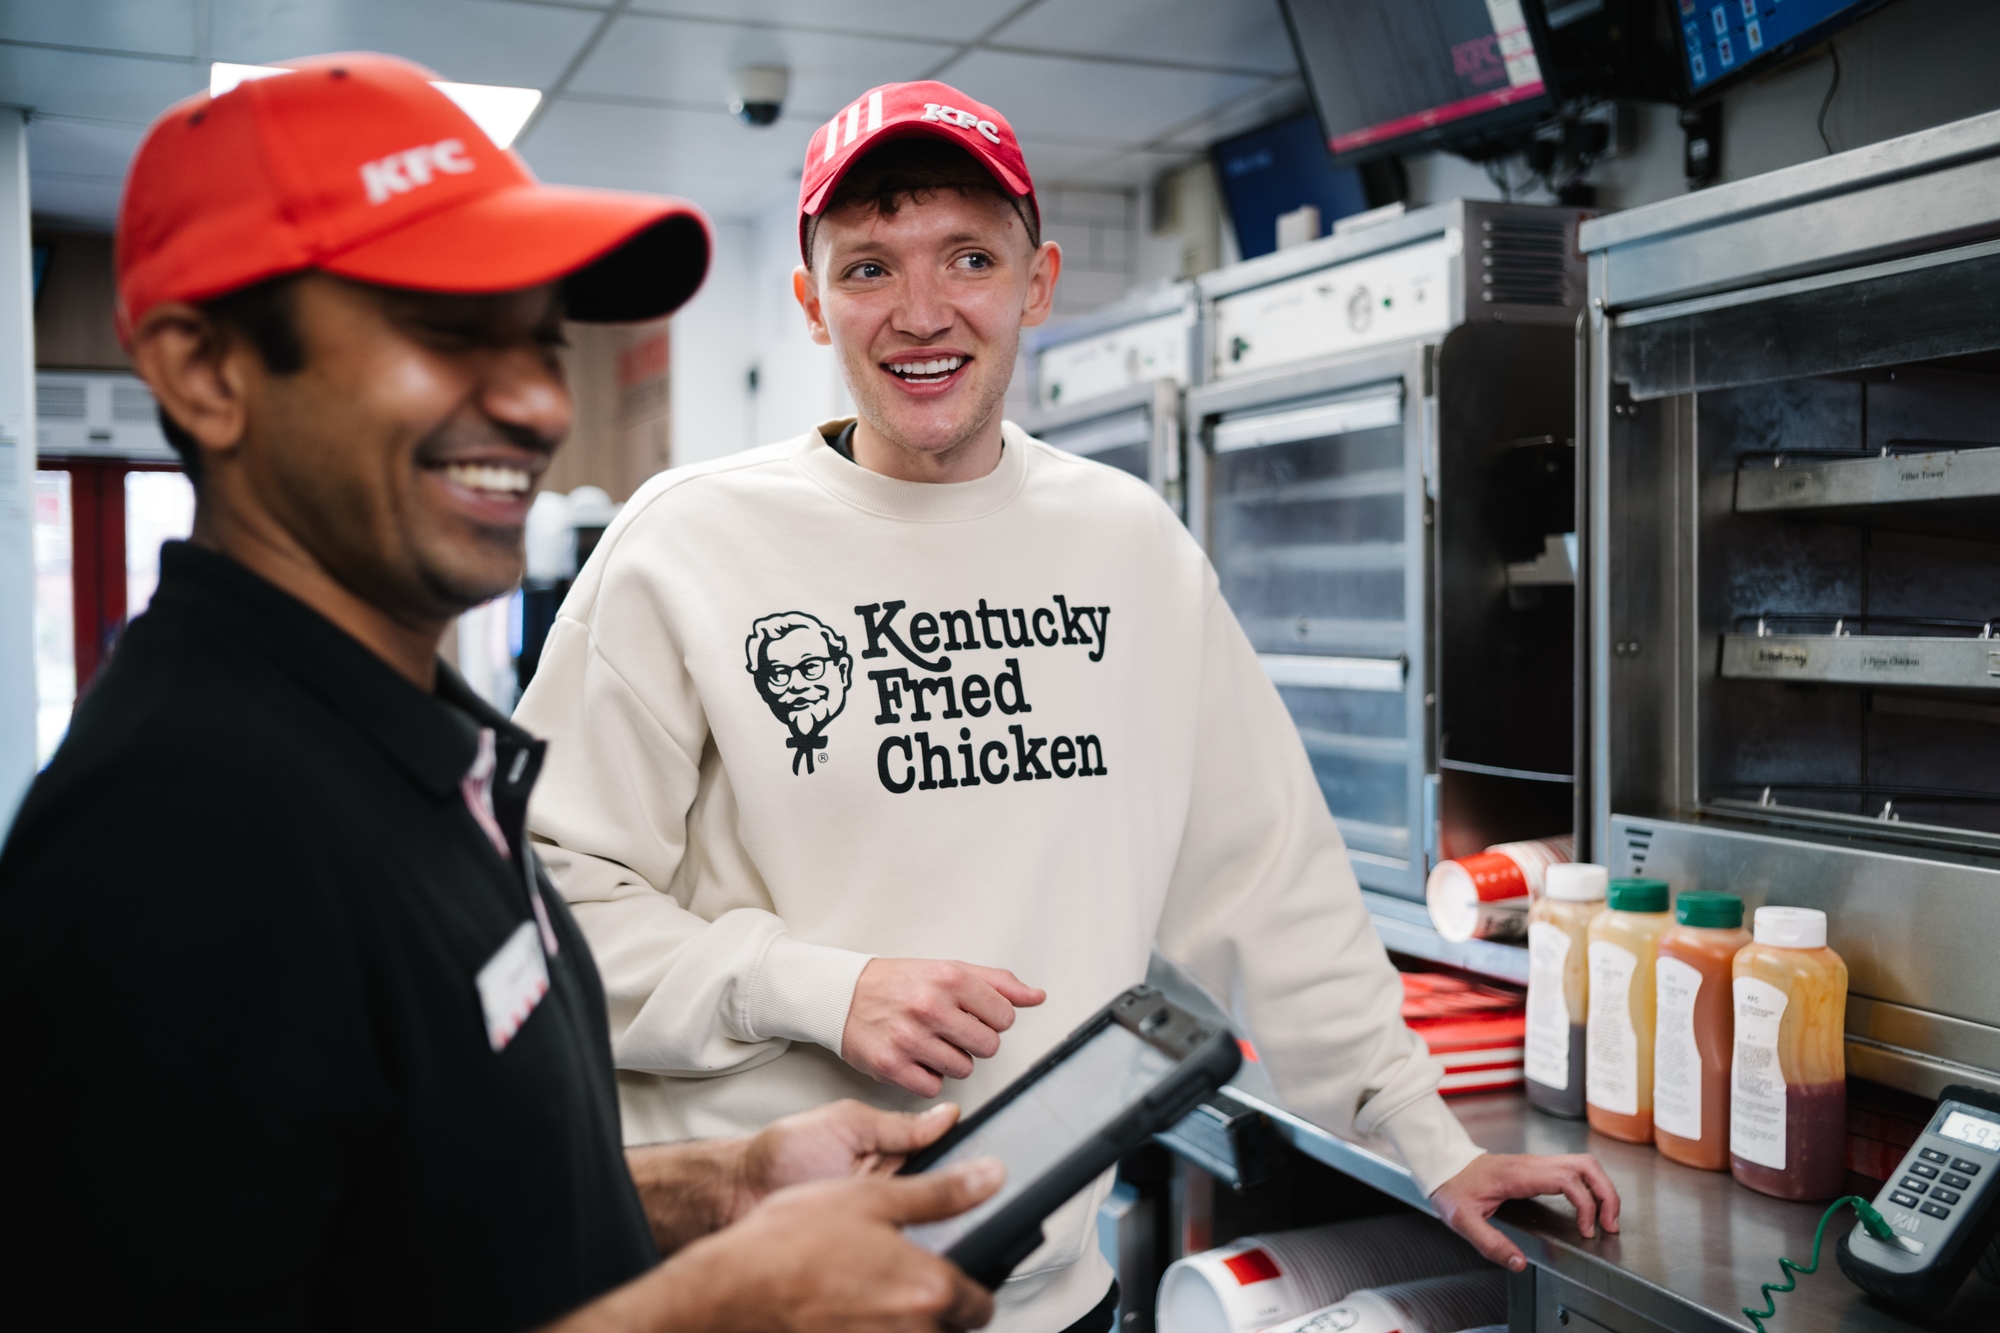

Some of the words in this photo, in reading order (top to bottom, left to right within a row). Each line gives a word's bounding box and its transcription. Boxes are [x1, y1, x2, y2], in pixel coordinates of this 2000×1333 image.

[921, 103, 1001, 145] KFC
[359, 138, 477, 205] KFC
[1901, 472, 1919, 482] Fillet
[1921, 470, 1945, 480] Tower
[854, 594, 1111, 672] Kentucky
[1889, 656, 1920, 666] Chicken
[867, 658, 1032, 725] Fried
[877, 724, 1108, 794] Chicken
[1896, 1193, 1911, 1203] HOLD
